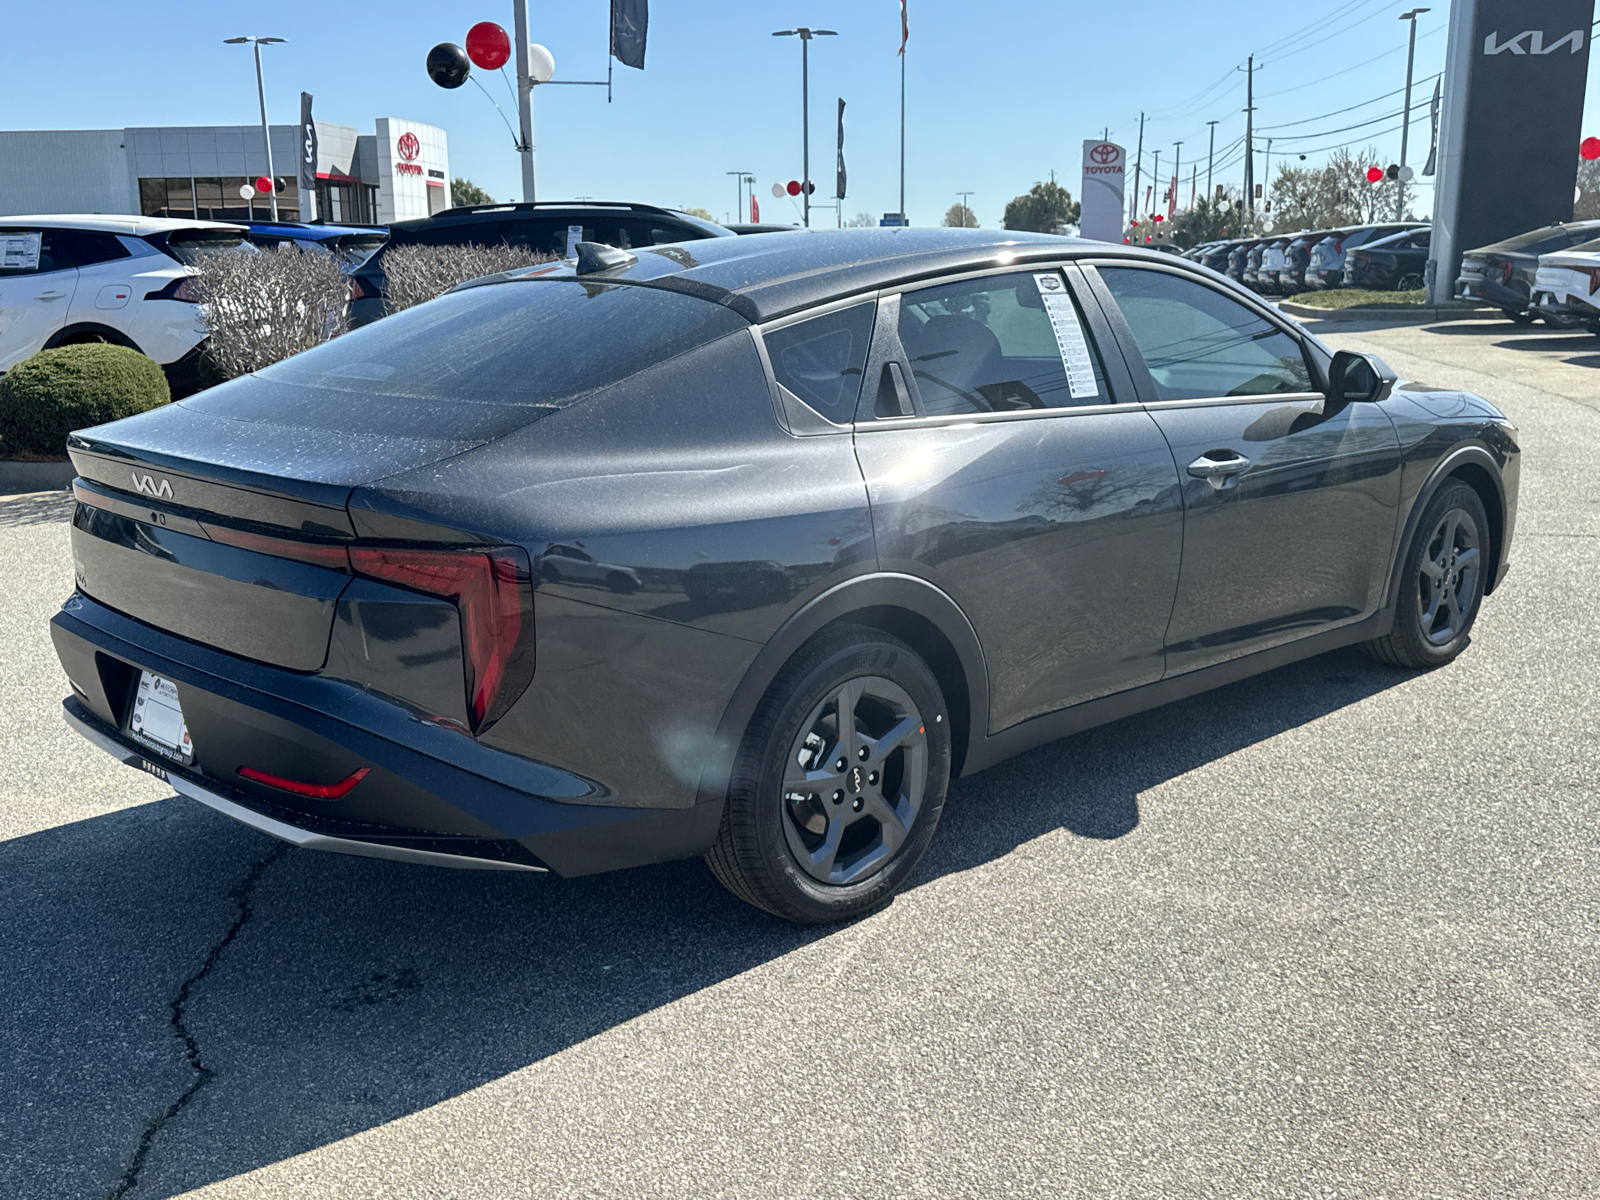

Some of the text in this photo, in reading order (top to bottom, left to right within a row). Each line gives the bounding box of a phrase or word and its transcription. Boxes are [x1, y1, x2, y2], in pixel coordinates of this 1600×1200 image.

[1484, 30, 1584, 55] KIA
[1085, 166, 1124, 175] TOYOTA
[131, 471, 174, 500] KIA
[831, 878, 892, 911] KUMHO
